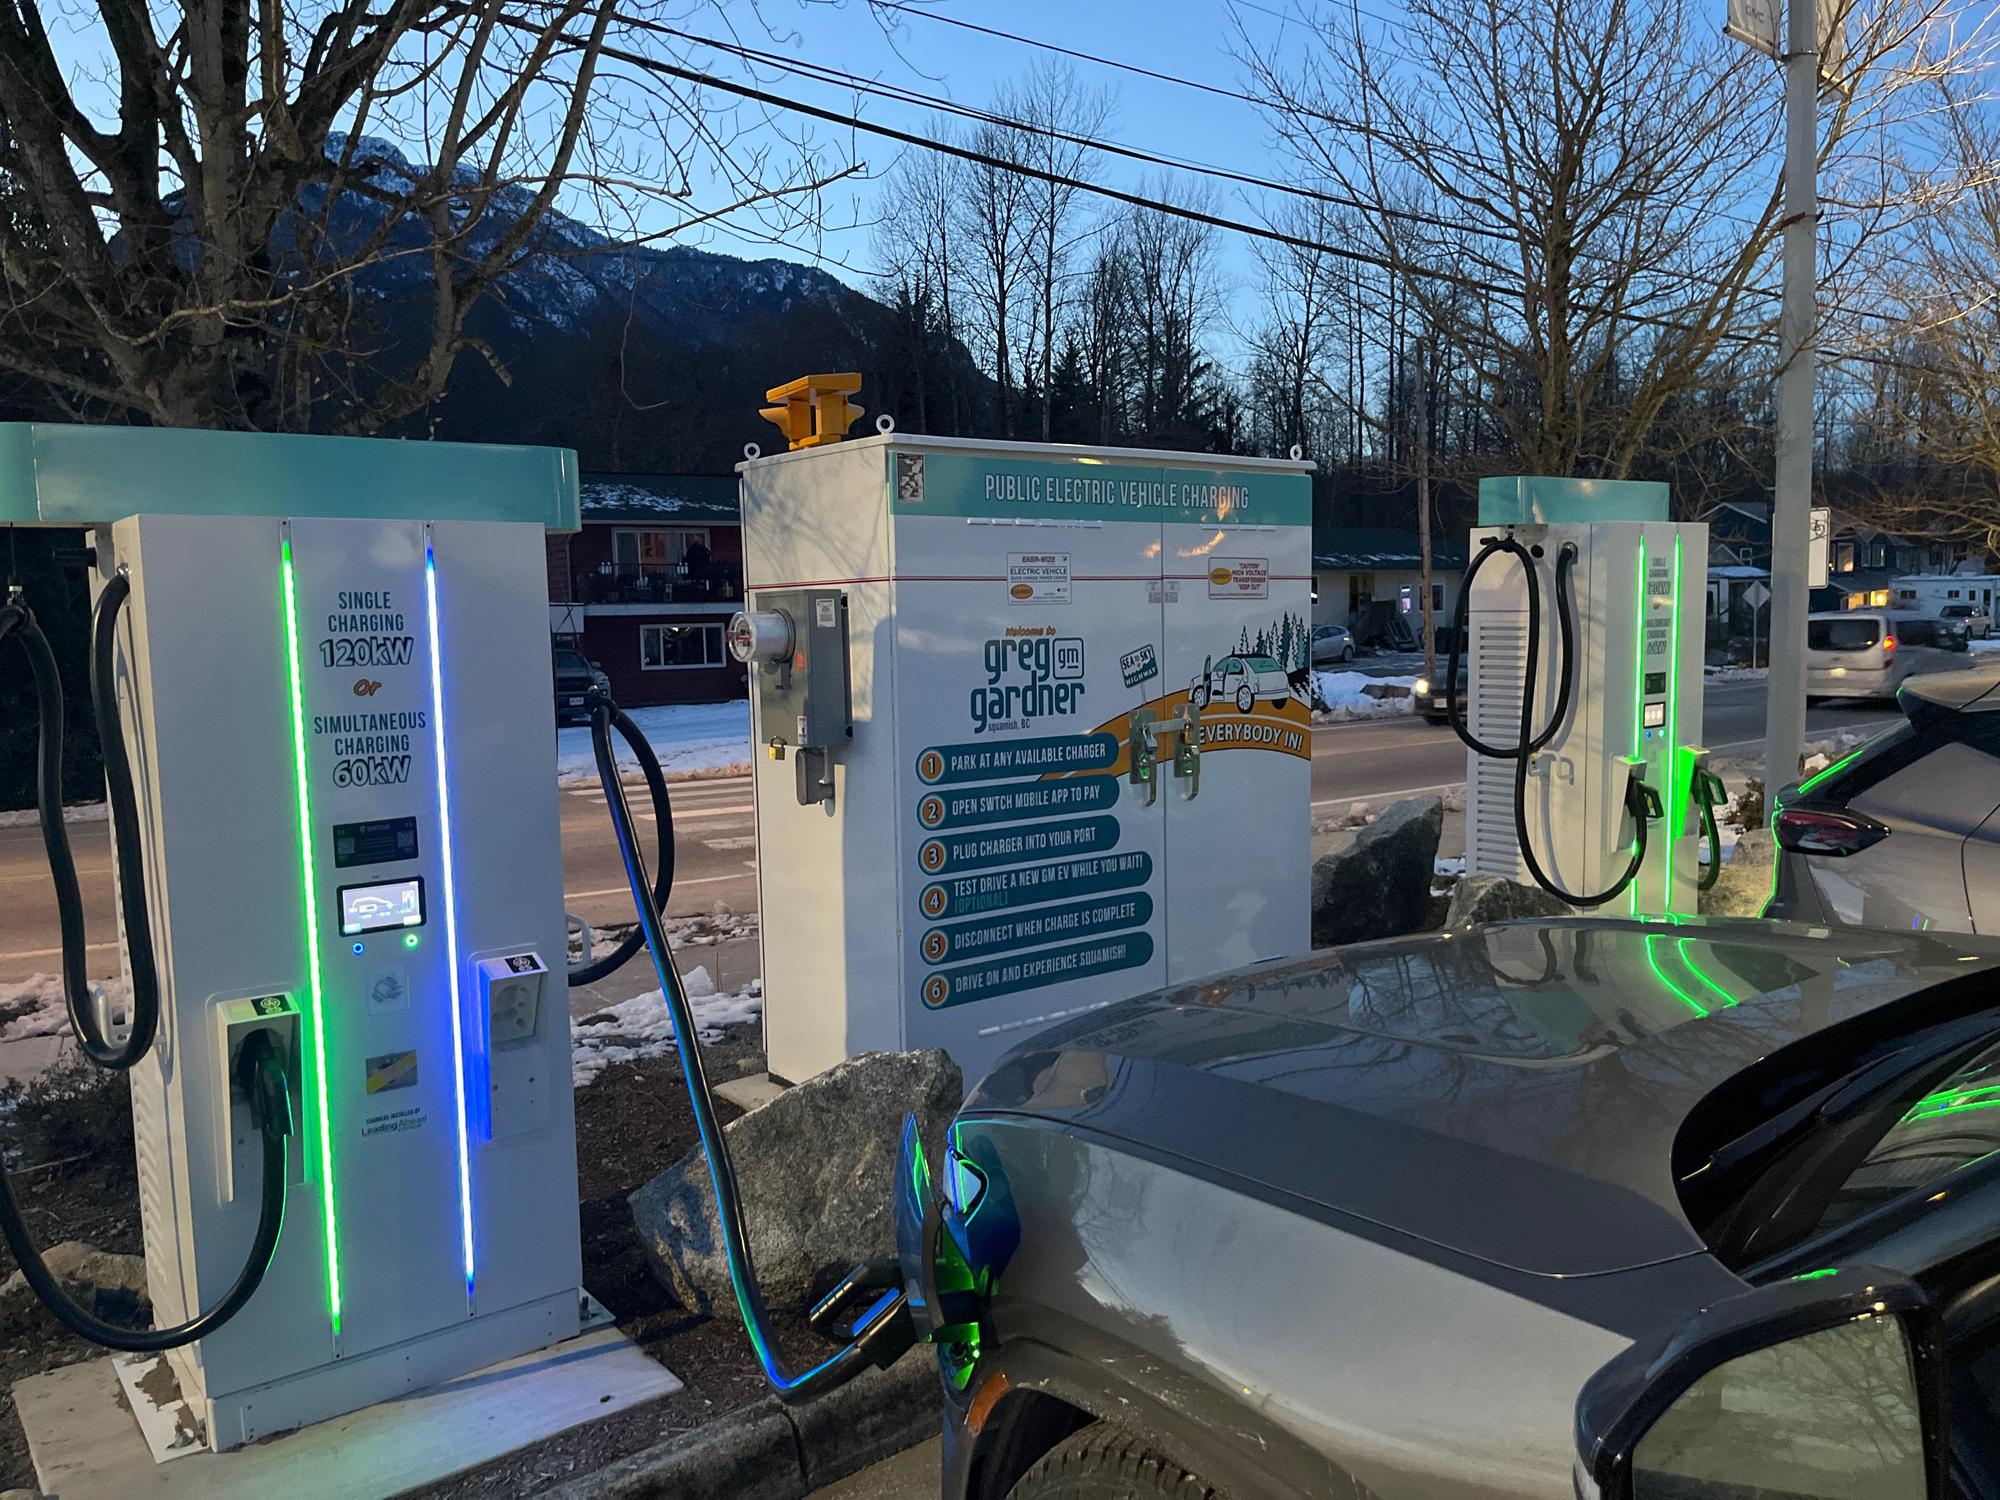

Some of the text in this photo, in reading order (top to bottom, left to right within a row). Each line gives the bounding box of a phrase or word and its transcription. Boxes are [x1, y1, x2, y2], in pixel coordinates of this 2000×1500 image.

[985, 474, 1249, 509] PUBLIC ELECTRIC VEHICLE CHARGING
[1010, 567, 1067, 575] ELECTRIC VEHICLE
[338, 592, 392, 609] SINGLE
[328, 614, 404, 632] CHARGING
[1006, 625, 1056, 637] Welcome to
[319, 636, 414, 667] 120kW
[985, 638, 1079, 685] greg gm
[1122, 656, 1135, 670] SEA
[1140, 648, 1153, 662] SKY
[353, 678, 382, 696] Or
[1125, 667, 1156, 686] HIGHWAY
[970, 670, 1085, 734] gardner
[314, 712, 426, 734] SIMULTANEOUS
[1021, 718, 1030, 729] BC
[1200, 723, 1304, 751] EVERYBODY IN!
[334, 734, 410, 755] CHARGING
[927, 743, 1106, 774] 1 PARK AT ANY AVAILABLE CHARGER
[333, 755, 411, 788] 60kW
[928, 785, 1100, 820] 2 OPEN SWTCH MOBILE APP TO PAY
[929, 827, 1097, 865] 3 PLUG CHARGER INTO YOUR PORT
[929, 854, 1143, 909] 4 TEST DRIVE A NEW GM EV WHILE YOU WAIT!
[930, 902, 1136, 954] 5 DISCONNECT WHEN CHARGE IS COMPLETE
[931, 944, 1127, 998] 6 DRIVE ON AND EXPERIENCE SQUAMISH!
[361, 1122, 398, 1137] Leading
